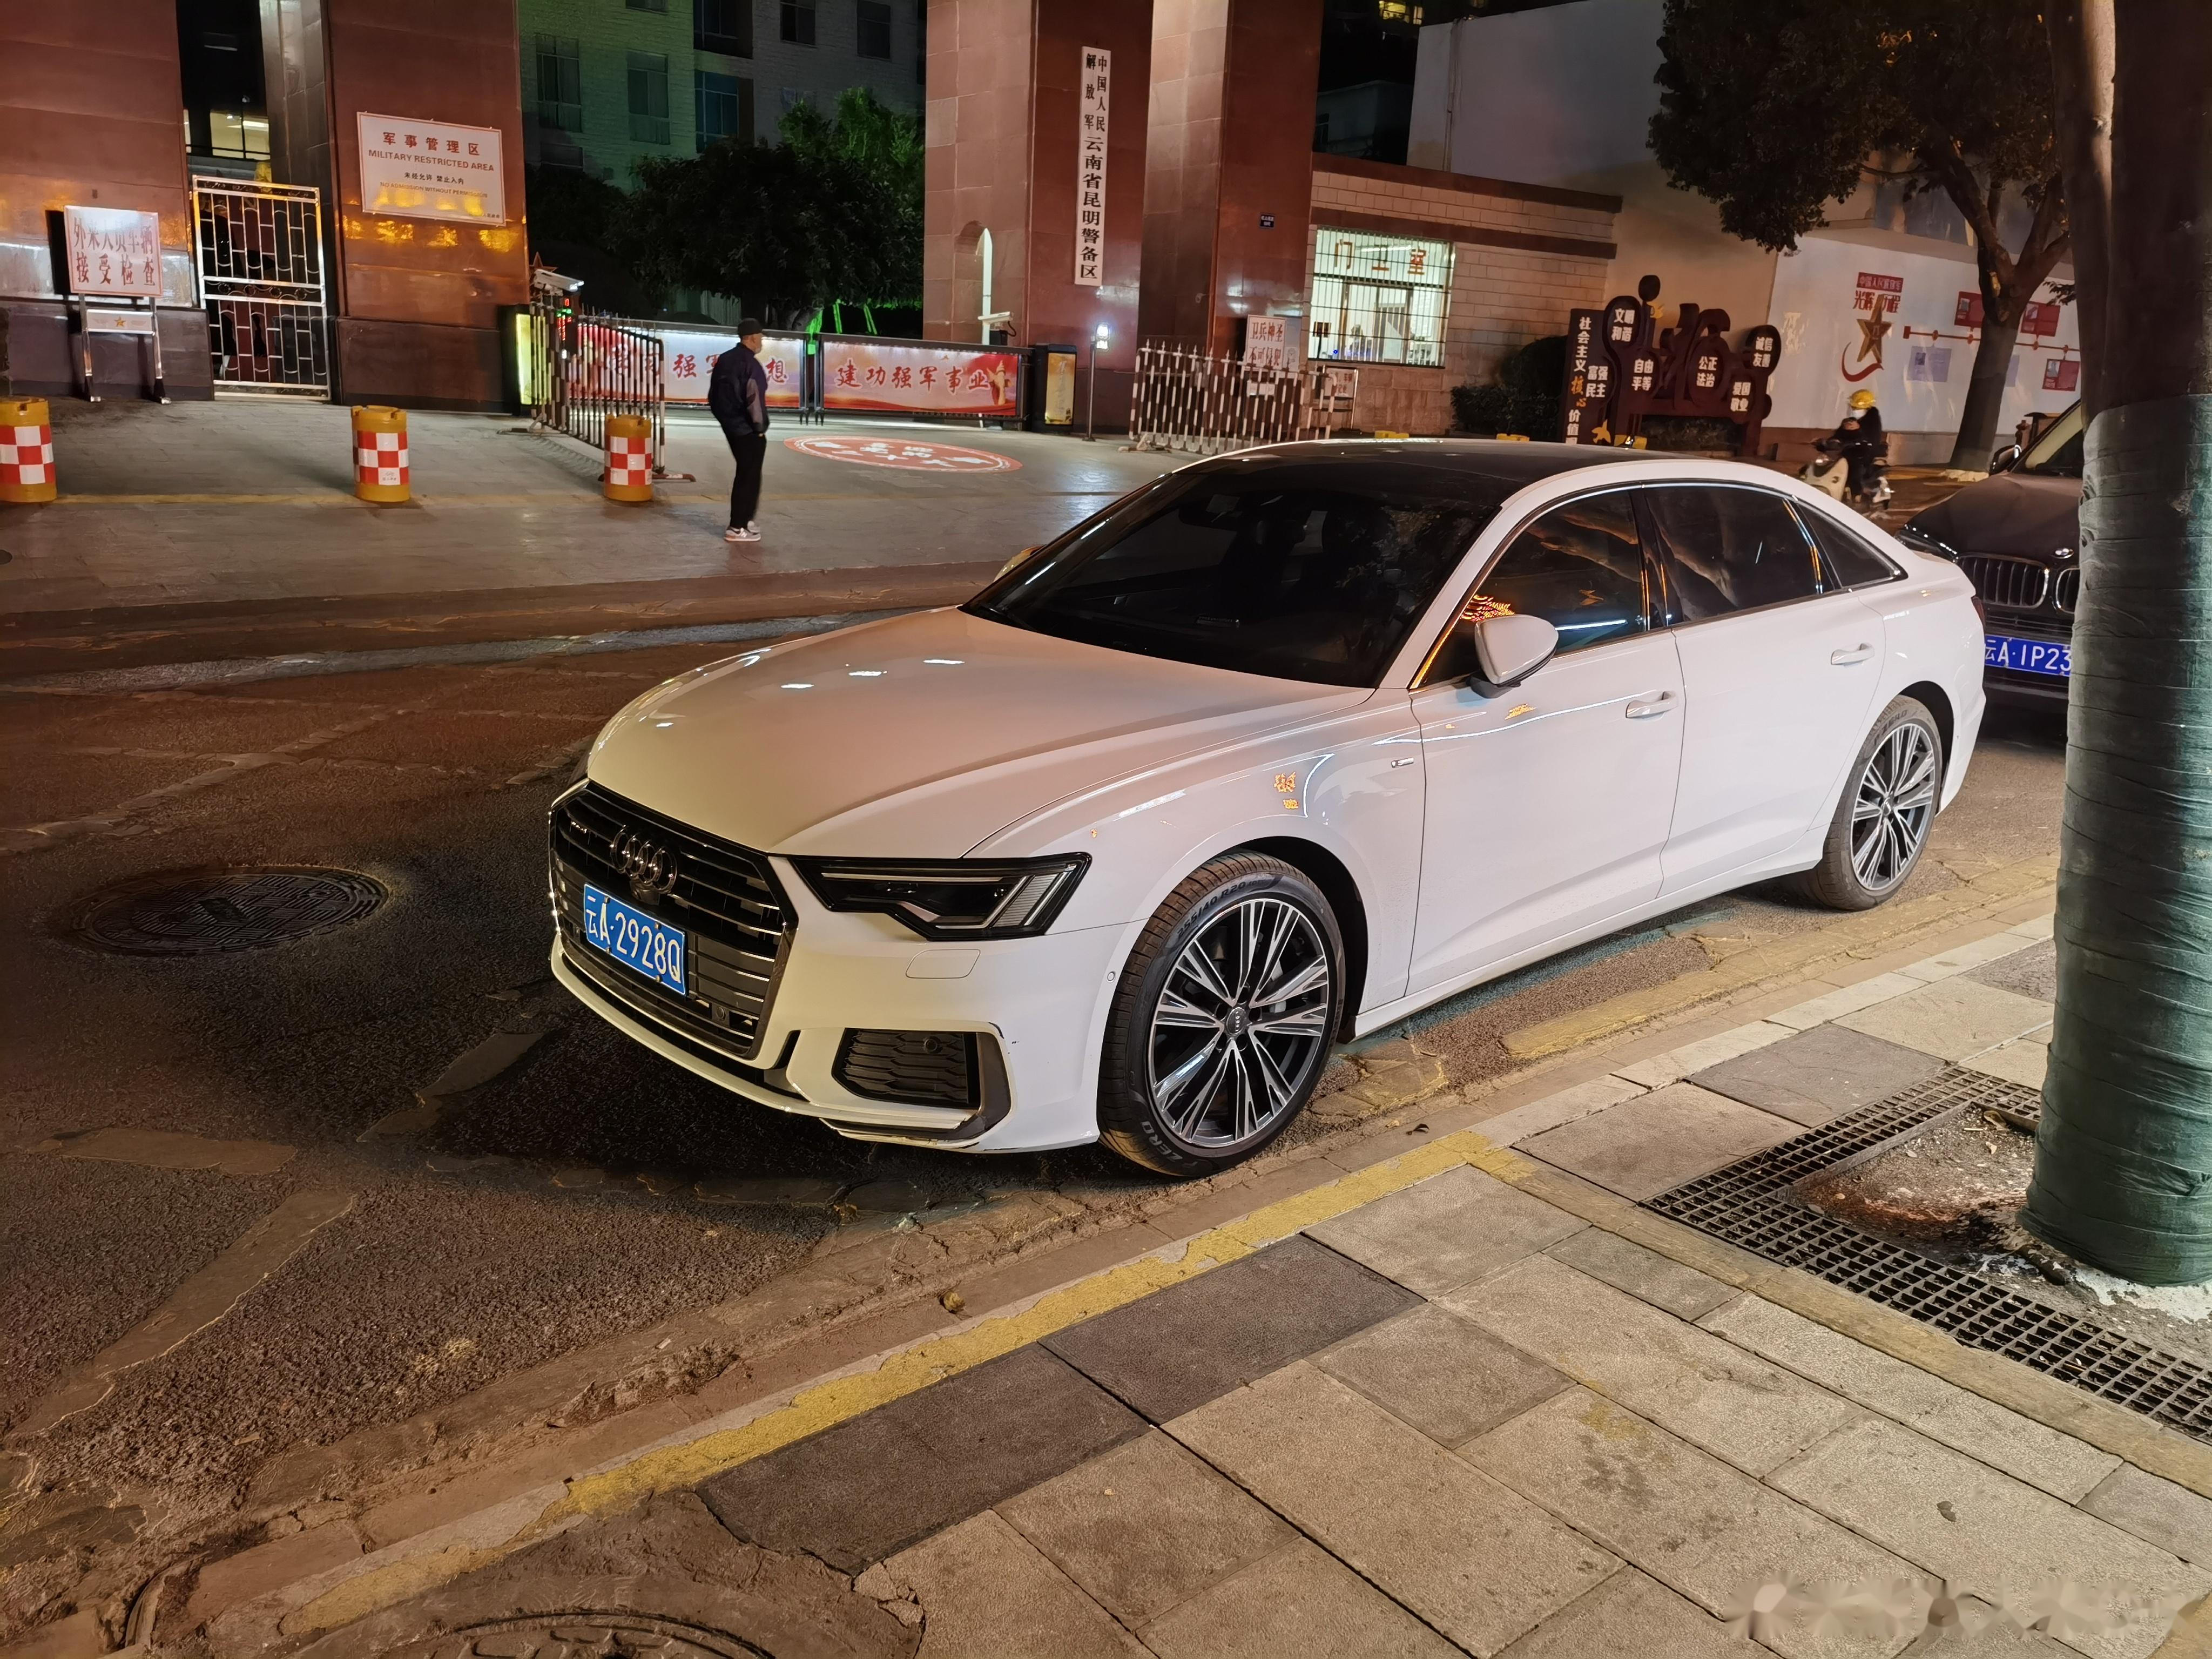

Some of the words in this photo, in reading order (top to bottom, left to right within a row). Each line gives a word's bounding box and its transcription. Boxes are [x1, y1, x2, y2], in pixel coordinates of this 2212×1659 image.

[1084, 53, 1096, 130] 解放军
[1096, 56, 1107, 132] 中国人民
[383, 132, 480, 156] 军事管理区
[368, 150, 412, 161] MILITARY
[414, 155, 468, 168] RESTRICTED
[470, 163, 494, 171] AREA
[404, 172, 432, 181] 未经允许
[436, 176, 464, 185] 禁止入内
[425, 186, 451, 194] WITHOUT
[1080, 136, 1104, 279] 云南省昆明警备区
[77, 251, 156, 286] 接受检查
[1614, 308, 1635, 324] 文明
[1250, 322, 1283, 342] 卫兵神圣
[1611, 326, 1632, 341] 和谐
[1756, 337, 1773, 352] 诚信
[1634, 359, 1654, 374] 自由
[1698, 356, 1718, 370] 公正
[1753, 353, 1771, 367] 友善
[837, 360, 990, 393] 建功强军事业
[1587, 366, 1608, 381] 富强
[1696, 373, 1715, 387] 法治
[1586, 383, 1606, 397] 民主
[1631, 376, 1652, 391] 平等
[1732, 382, 1751, 395] 爱国
[1730, 398, 1748, 412] 敬业
[1220, 881, 1246, 899] R20
[1141, 1121, 1183, 1162] ZERO
